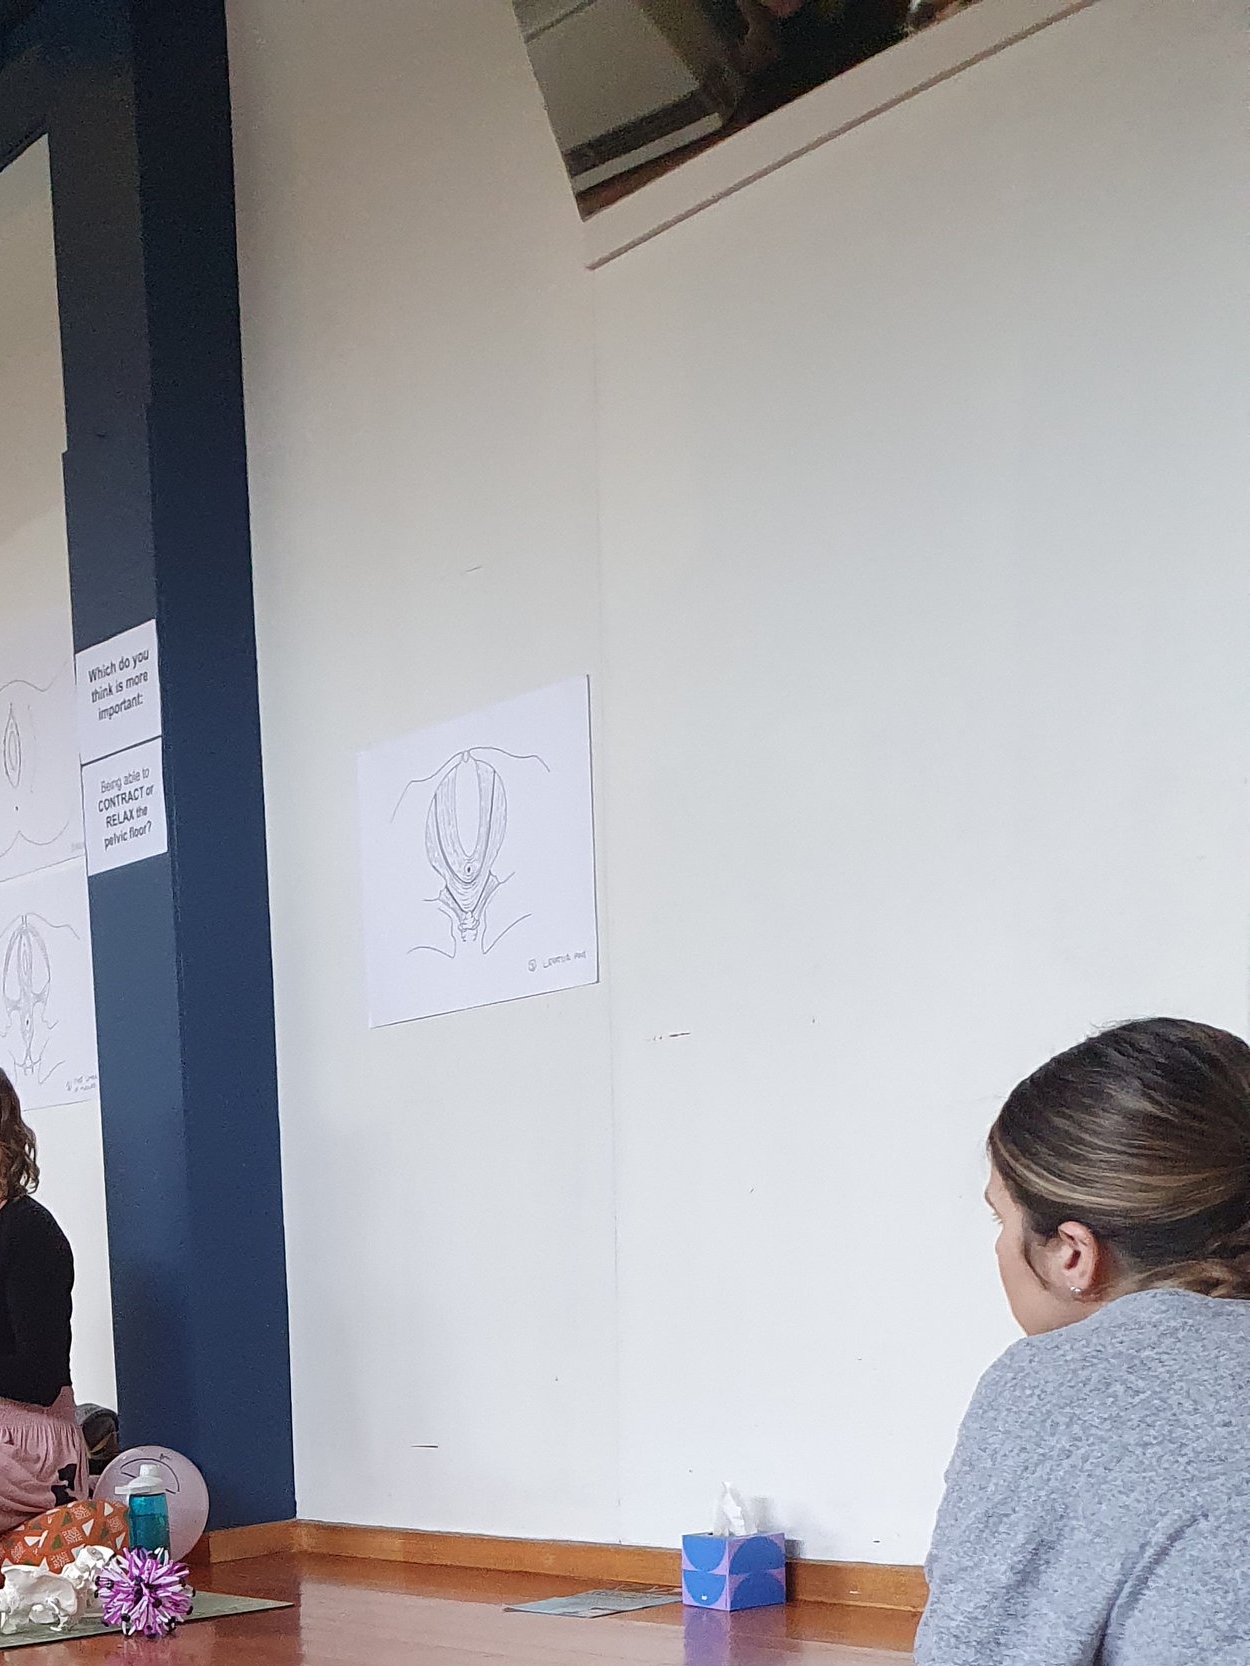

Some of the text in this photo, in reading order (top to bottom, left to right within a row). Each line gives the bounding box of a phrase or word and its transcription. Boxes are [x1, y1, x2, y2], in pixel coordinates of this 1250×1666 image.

[88, 649, 149, 683] Which do you
[91, 671, 148, 703] think is more
[98, 692, 143, 720] important:
[101, 768, 150, 793] Being able to
[98, 784, 154, 812] CONTRACT or
[106, 805, 148, 828] RELAX the
[104, 830, 128, 851] pelvic
[129, 820, 152, 839] floor?
